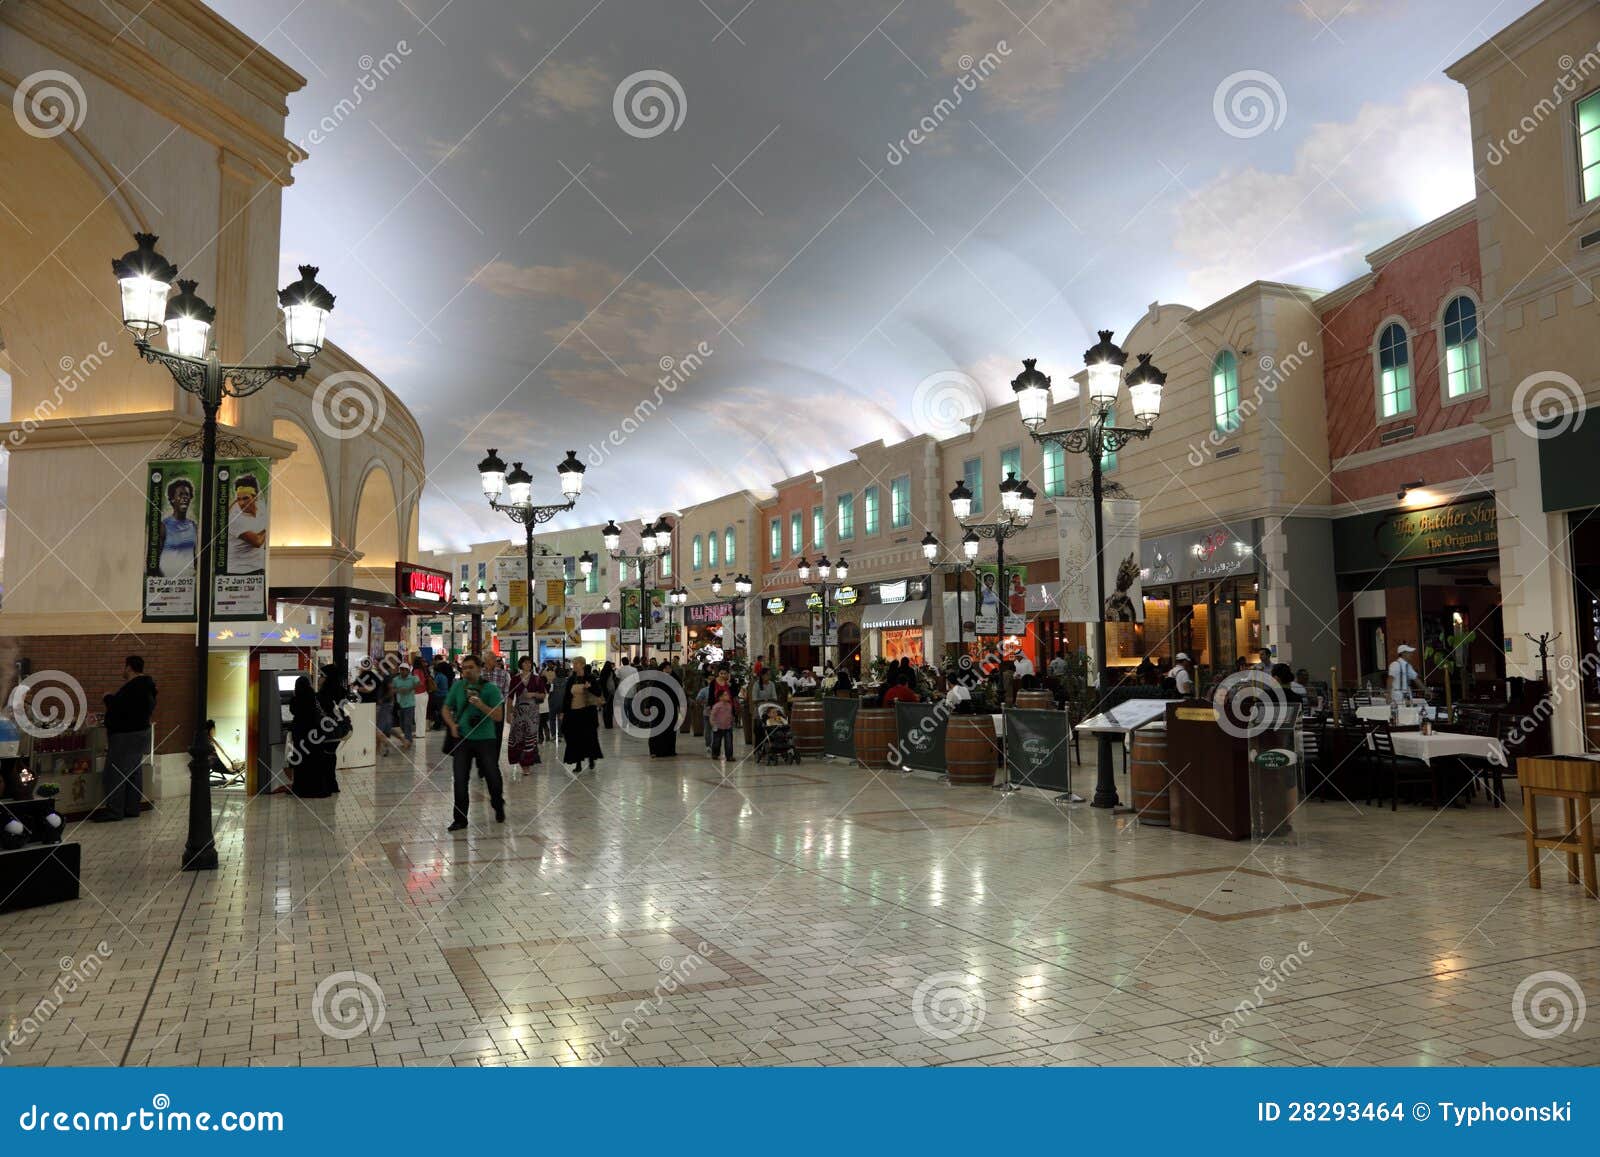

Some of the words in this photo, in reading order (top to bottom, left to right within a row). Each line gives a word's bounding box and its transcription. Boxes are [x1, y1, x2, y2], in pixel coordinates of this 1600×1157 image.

[1420, 507, 1465, 531] Butcher
[1469, 502, 1497, 529] Shop
[1424, 535, 1441, 549] The
[1445, 530, 1482, 547] Original
[1485, 531, 1498, 540] an
[177, 578, 194, 586] 2012
[231, 577, 245, 585] Jan
